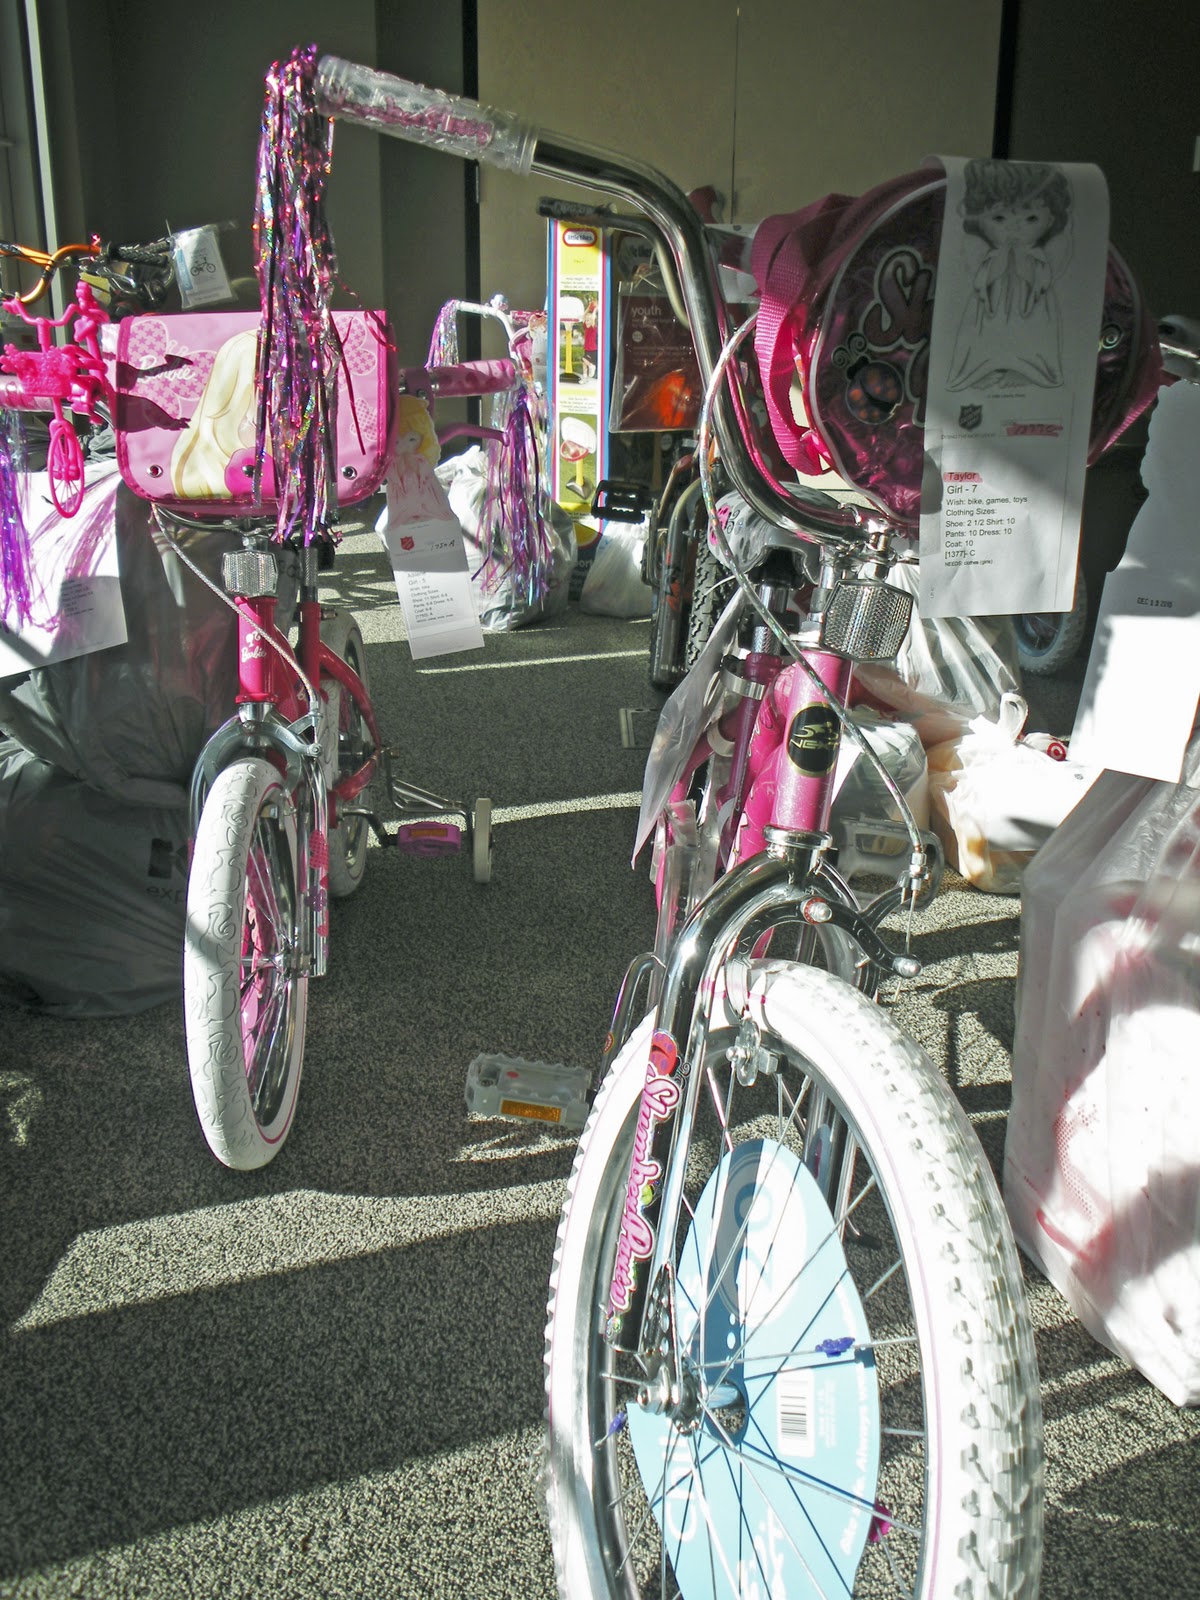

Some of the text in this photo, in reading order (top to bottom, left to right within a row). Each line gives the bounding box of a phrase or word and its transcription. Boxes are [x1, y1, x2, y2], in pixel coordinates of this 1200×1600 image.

[631, 305, 662, 317] youth
[137, 354, 196, 384] Barbie
[948, 472, 977, 482] Taylor
[947, 485, 963, 494] Girl
[972, 485, 978, 493] 7
[986, 498, 1011, 506] games,
[1013, 496, 1028, 504] toys
[945, 509, 974, 517] Clothing
[945, 520, 965, 528] Shoe:
[986, 518, 1004, 526] Shirt:
[945, 530, 966, 538] Pants:
[945, 540, 963, 548] Coat:
[969, 549, 976, 557] C
[1136, 597, 1149, 605] DEC
[241, 646, 267, 663] Barbie
[611, 1198, 654, 1308] Party
